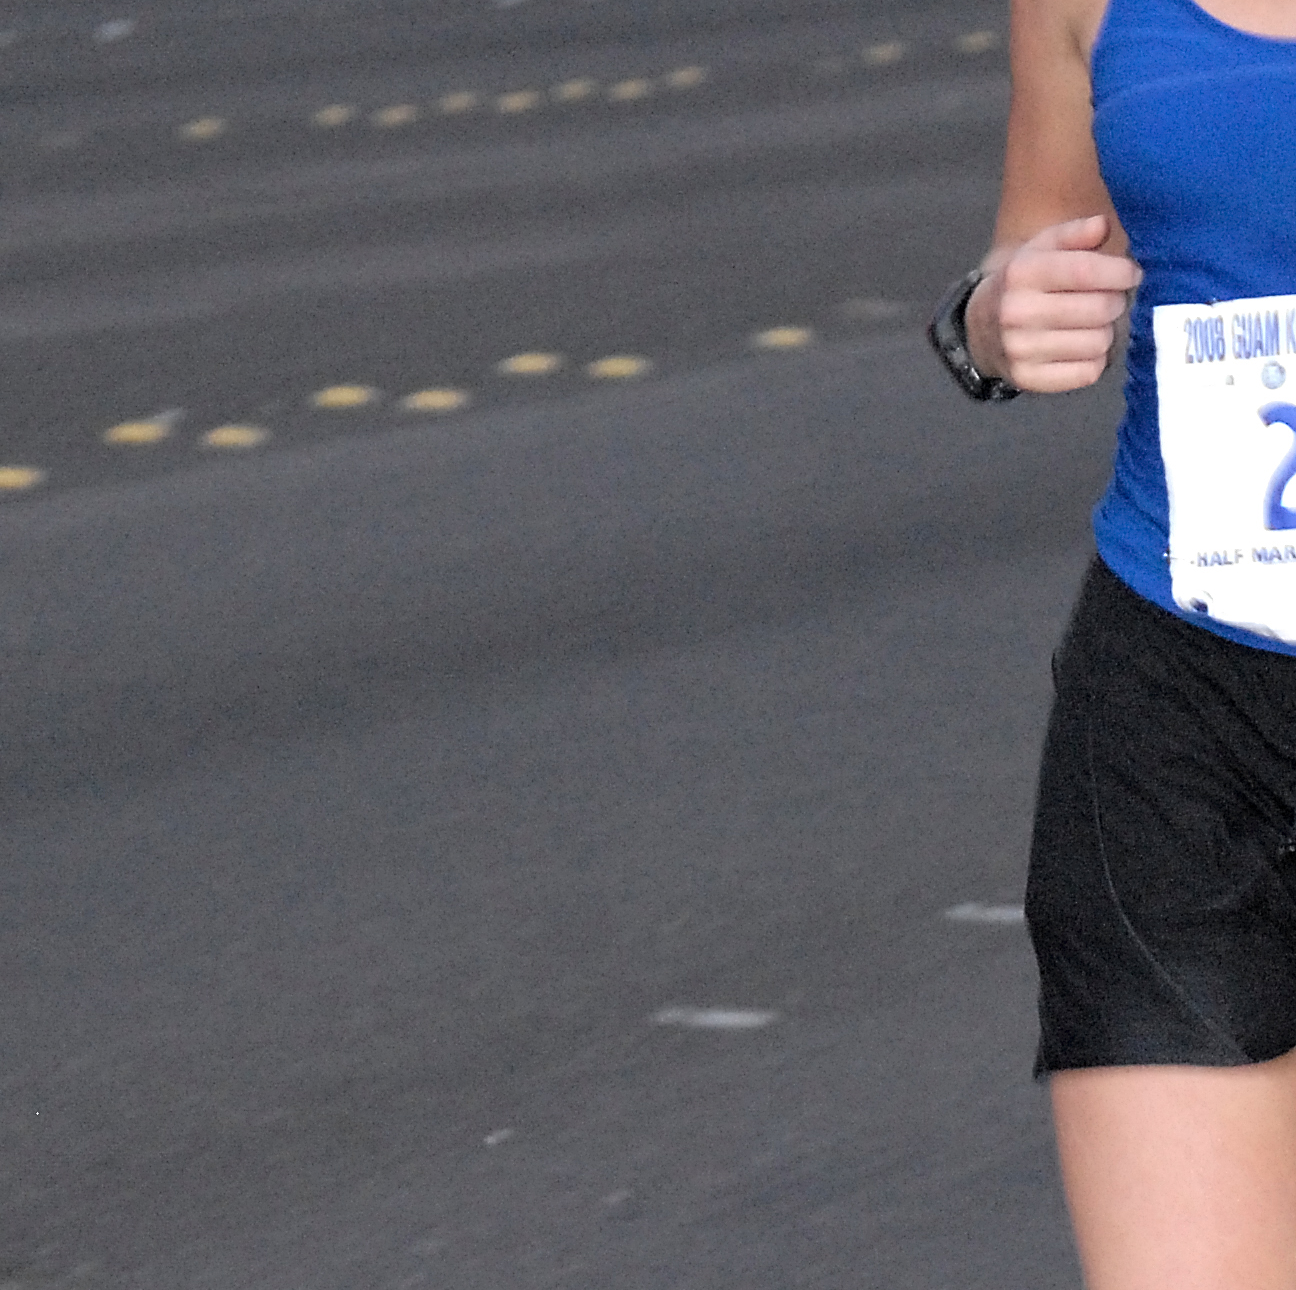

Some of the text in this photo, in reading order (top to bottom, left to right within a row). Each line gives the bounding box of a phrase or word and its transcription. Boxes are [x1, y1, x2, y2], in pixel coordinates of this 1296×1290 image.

[1184, 314, 1226, 364] 2008
[1232, 310, 1280, 359] GUAM
[1197, 548, 1244, 567] HALF
